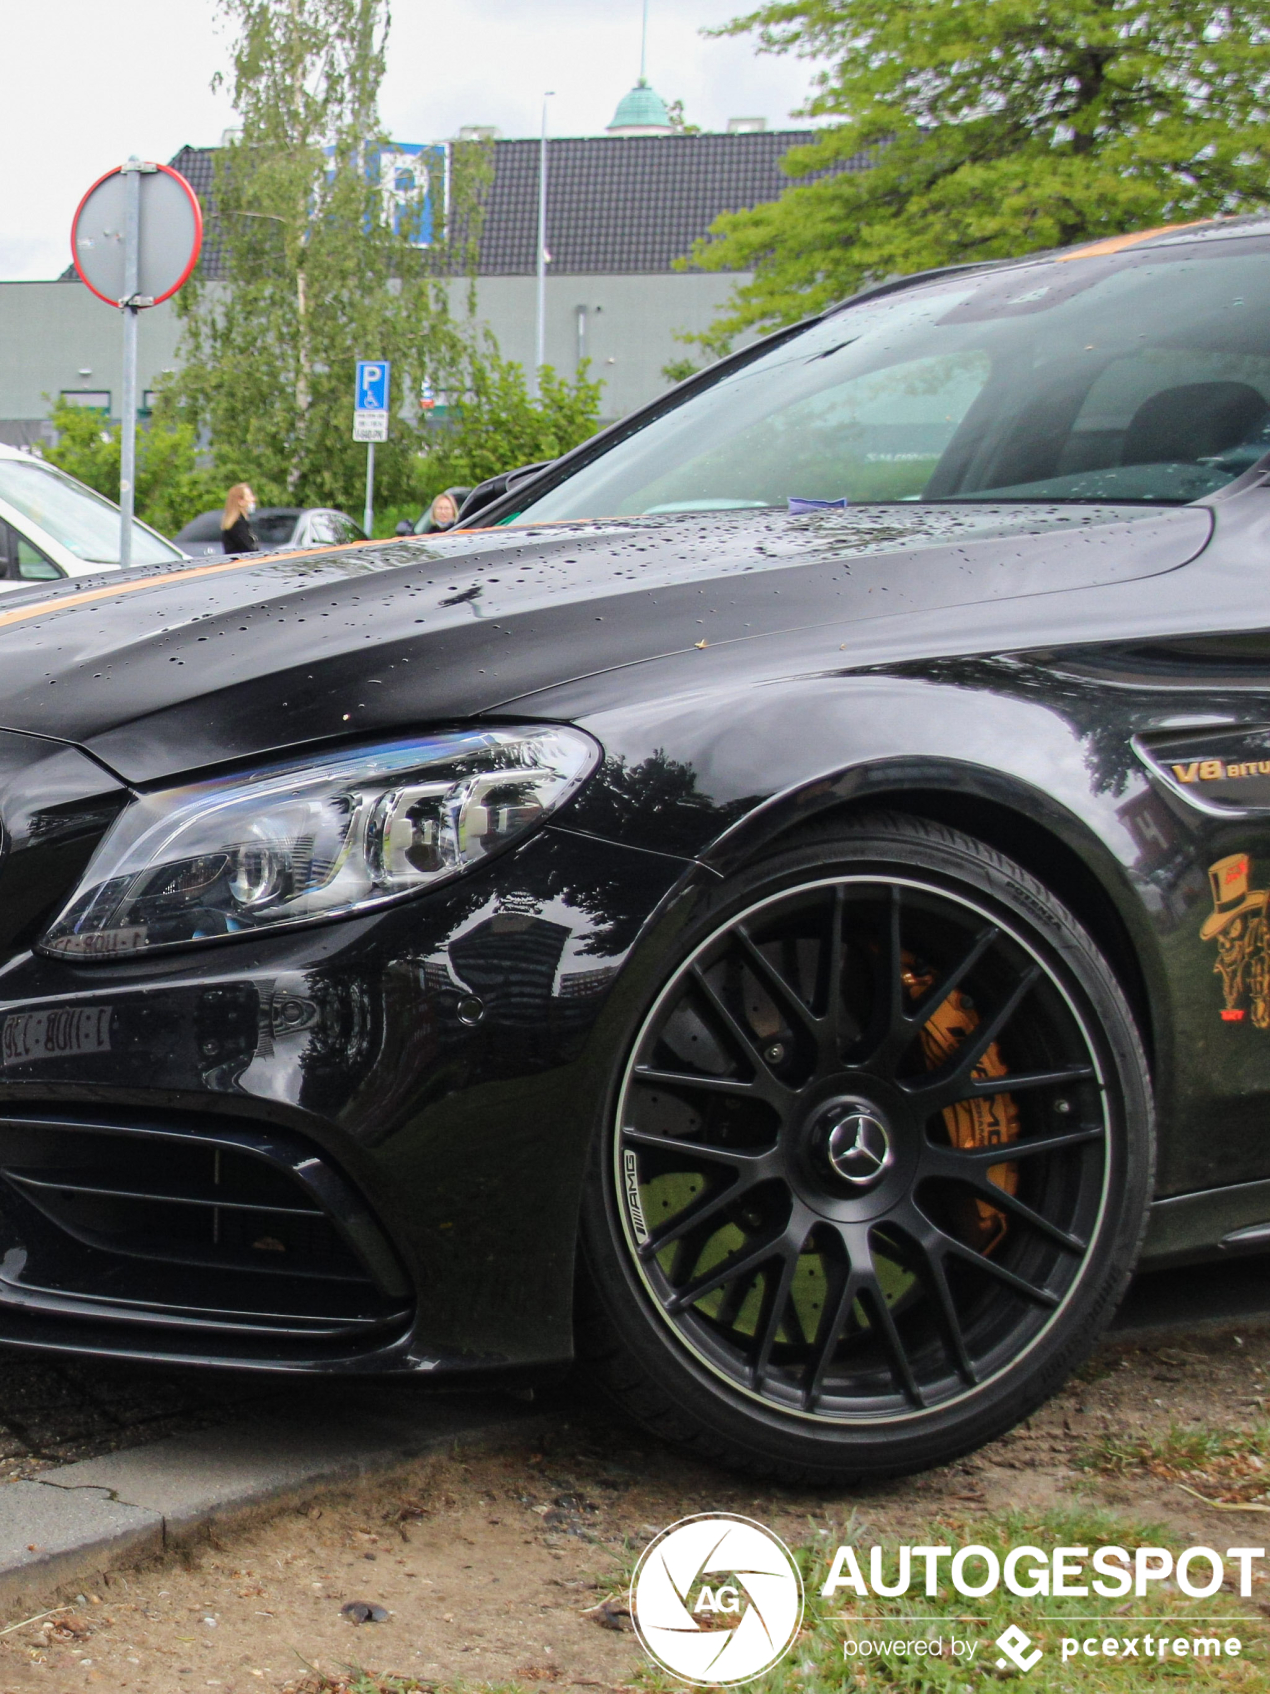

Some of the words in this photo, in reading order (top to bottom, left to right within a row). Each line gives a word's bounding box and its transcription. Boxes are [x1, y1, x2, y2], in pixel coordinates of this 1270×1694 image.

[380, 152, 429, 229] P
[362, 366, 381, 390] P
[1171, 760, 1223, 783] V8
[1005, 880, 1063, 932] POTENZA
